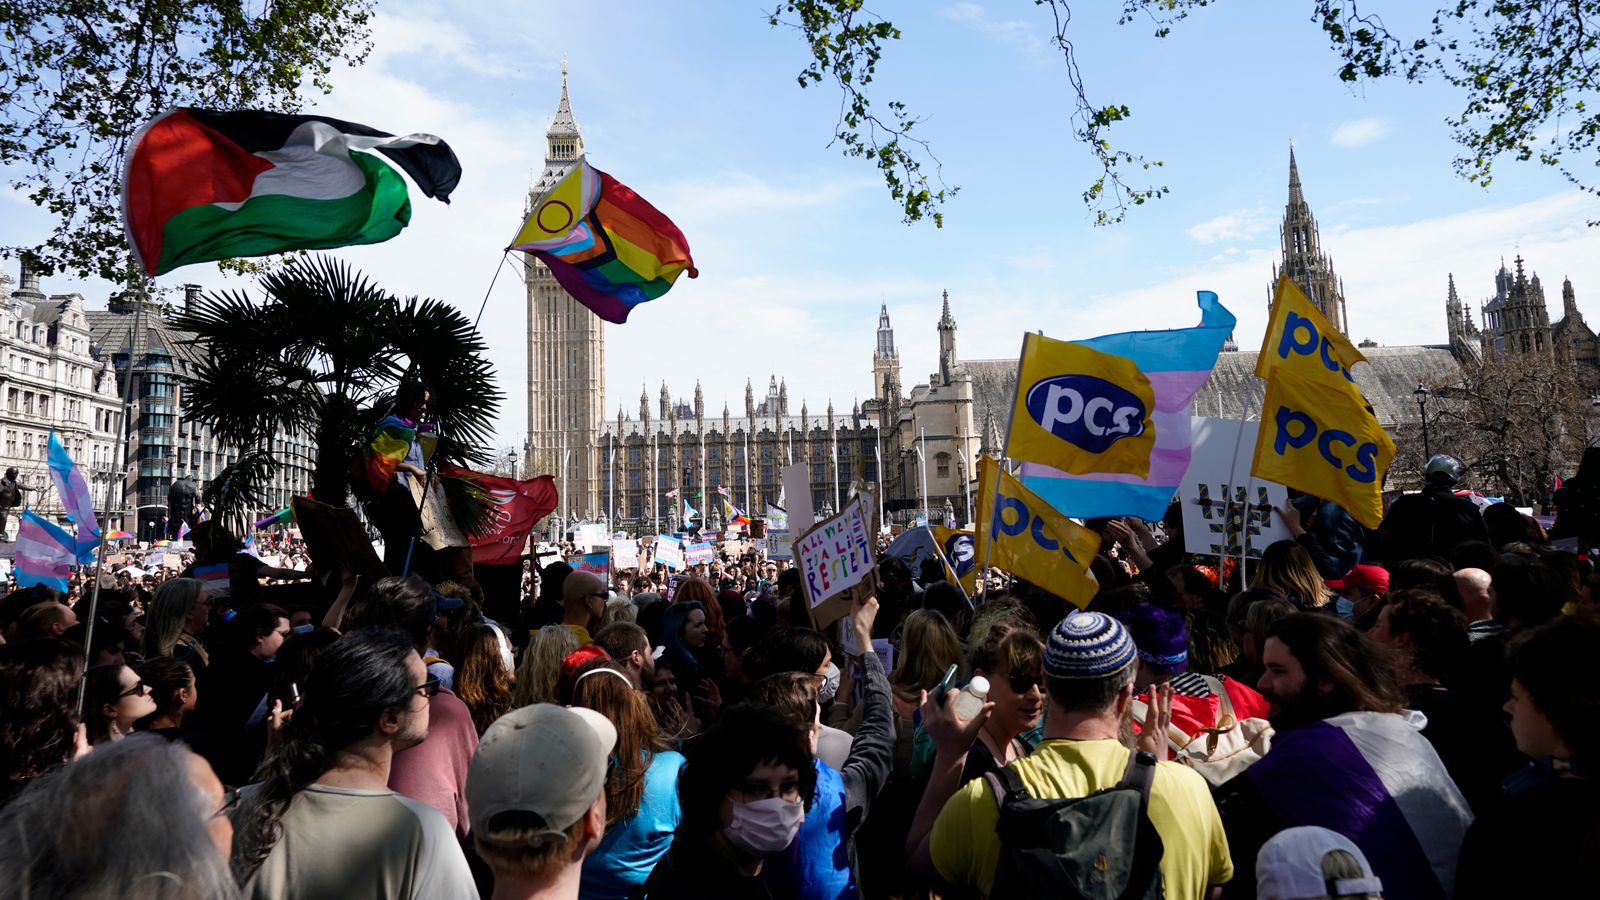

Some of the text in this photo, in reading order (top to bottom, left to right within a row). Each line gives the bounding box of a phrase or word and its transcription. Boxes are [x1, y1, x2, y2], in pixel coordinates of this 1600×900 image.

[1278, 311, 1355, 382] pc
[1041, 384, 1139, 436] pcs
[1274, 406, 1378, 484] pcs
[801, 534, 823, 556] ALL
[824, 522, 844, 539] WE
[822, 548, 830, 560] A
[992, 493, 1079, 564] pc
